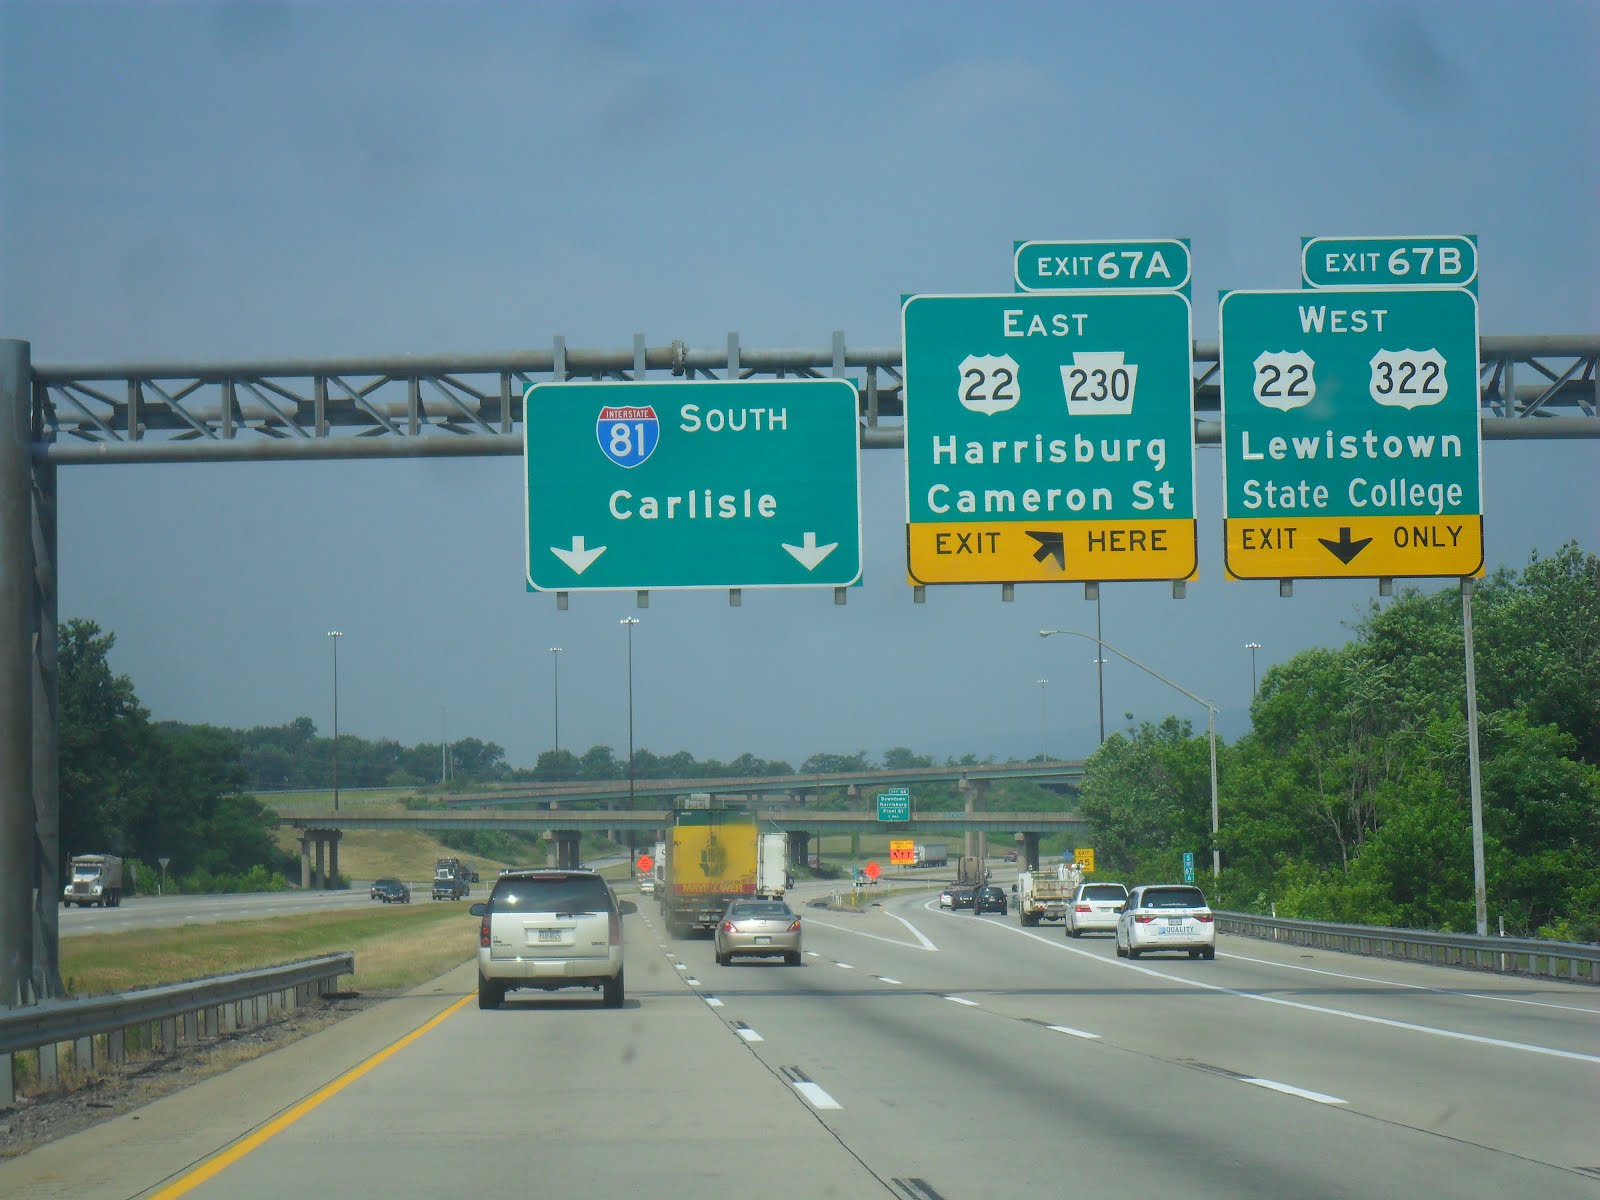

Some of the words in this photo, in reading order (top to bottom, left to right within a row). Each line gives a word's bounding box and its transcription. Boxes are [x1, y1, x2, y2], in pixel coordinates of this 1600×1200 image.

[1037, 256, 1093, 277] EXIT
[1097, 250, 1172, 280] 67A
[1325, 252, 1381, 273] EXIT
[1387, 247, 1463, 276] 67B
[1003, 308, 1088, 338] EAST
[1298, 304, 1388, 334] WEST
[963, 367, 1014, 401] 22
[1069, 367, 1130, 402] 230
[1259, 364, 1310, 397] 22
[1375, 361, 1441, 395] 322
[606, 408, 649, 419] INTERSTATE
[680, 403, 788, 432] SOUTH
[609, 422, 645, 458] 81
[932, 433, 1166, 472] Harrisburg
[1241, 429, 1462, 461] Lewistown
[608, 488, 777, 520] Carlisle
[927, 483, 1113, 514] Cameron
[1131, 480, 1176, 511] St
[1242, 478, 1329, 509] State
[1348, 477, 1464, 516] College
[935, 531, 1001, 555] EXIT
[1087, 529, 1169, 553] HERE
[1242, 526, 1297, 550] EXIT
[1393, 525, 1463, 549] ONLY
